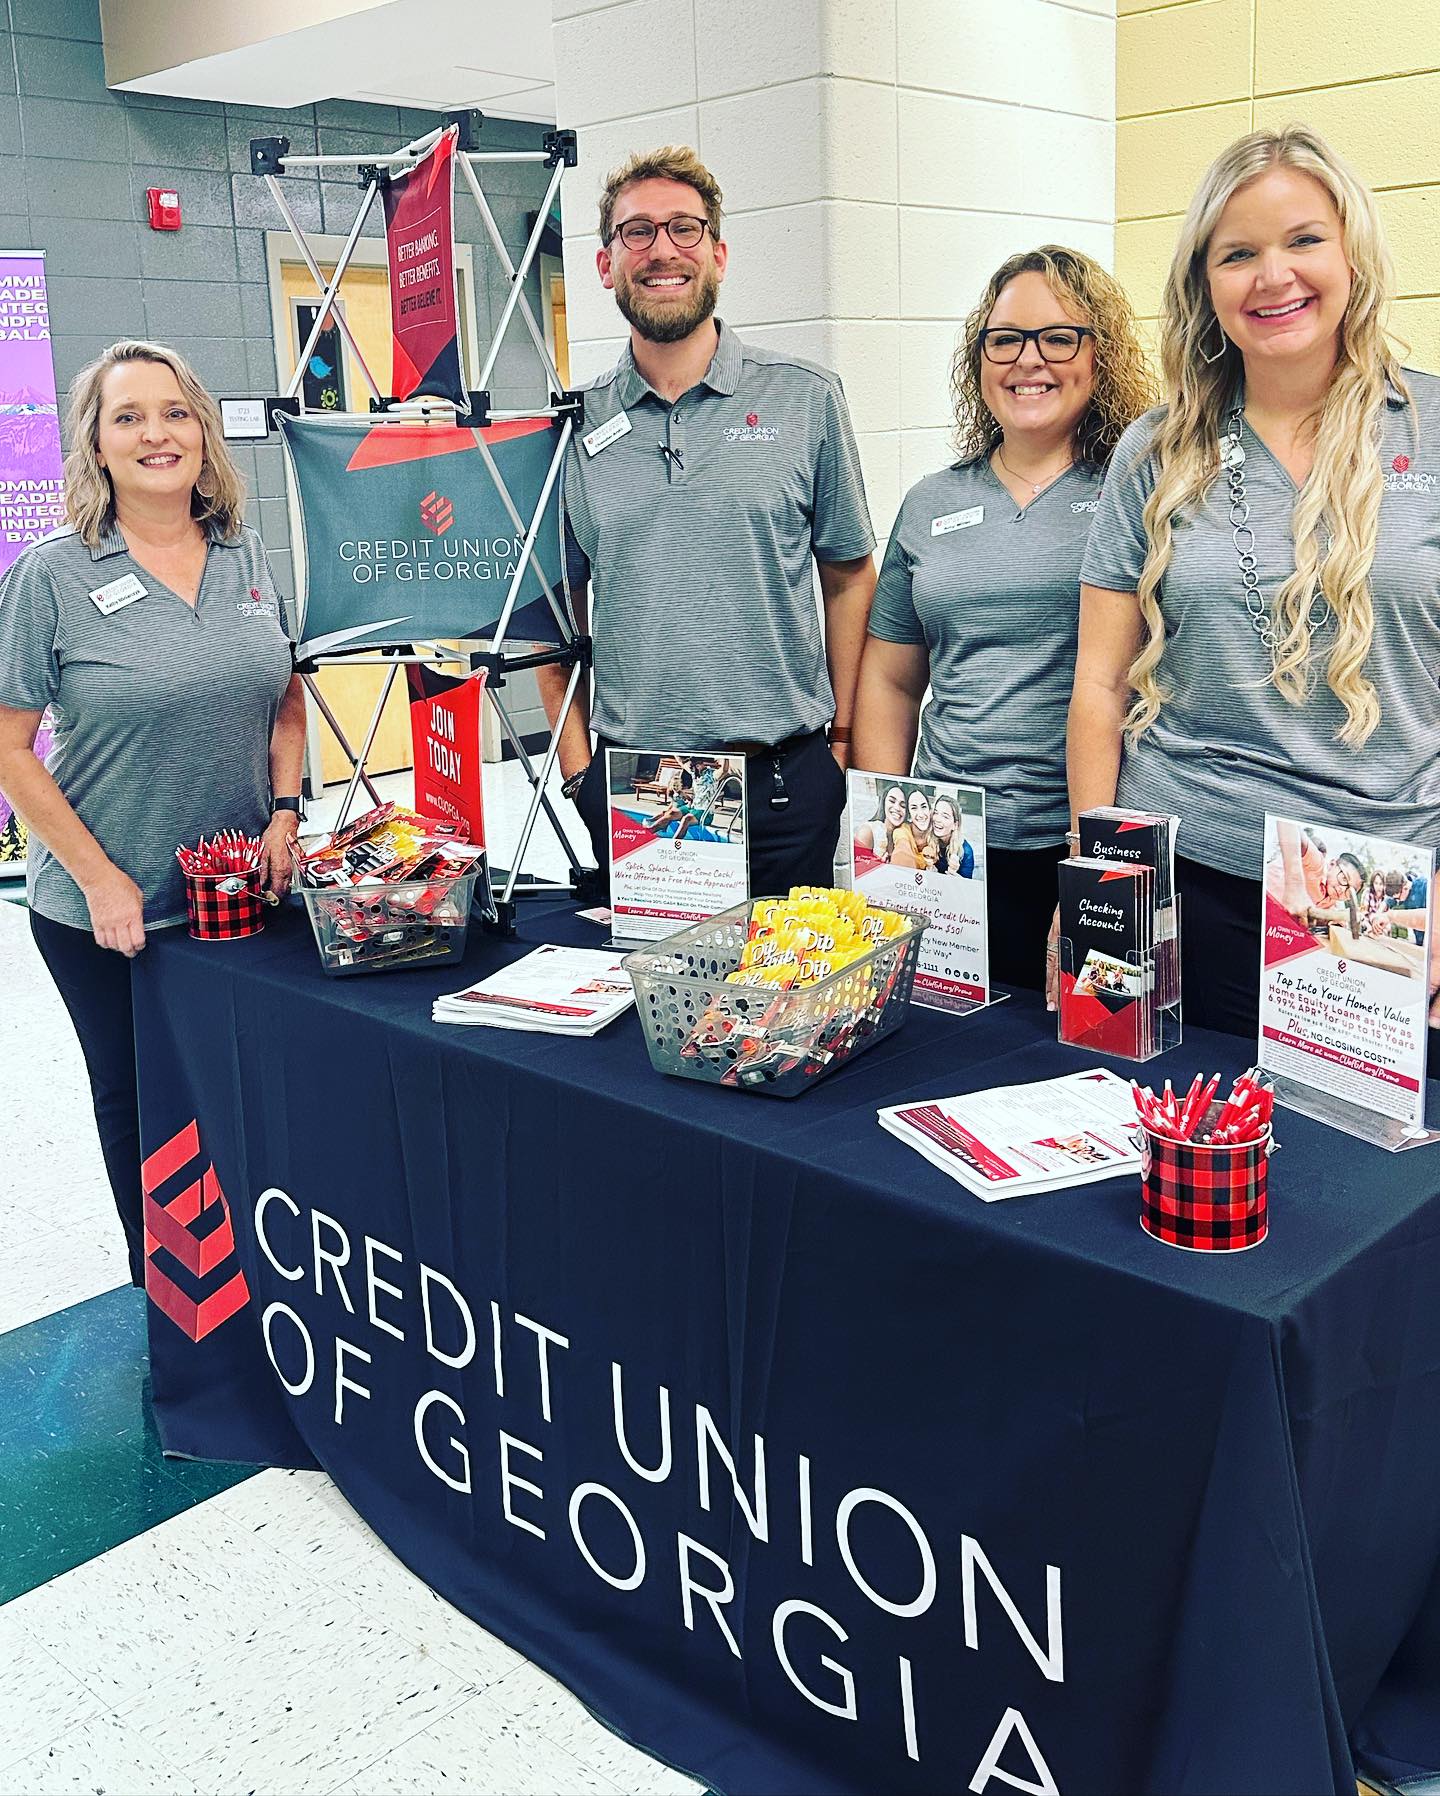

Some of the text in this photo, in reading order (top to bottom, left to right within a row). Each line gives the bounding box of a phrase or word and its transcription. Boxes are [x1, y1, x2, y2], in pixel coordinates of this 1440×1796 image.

[398, 242, 414, 262] BETTER
[399, 267, 416, 289] BETTER
[723, 427, 779, 435] CREDIT UNION
[1384, 482, 1431, 493] GEORGIA
[1402, 473, 1437, 484] UNION
[339, 537, 526, 561] CREDIT UNION
[352, 561, 519, 584] OF GEORGIA
[430, 702, 455, 743] JOIN
[427, 735, 462, 785] TODAY
[613, 831, 637, 842] Money
[1093, 841, 1141, 859] Business
[677, 866, 693, 875] Save
[695, 867, 712, 877] Some
[685, 876, 702, 885] Home
[895, 882, 942, 897] CREDIT UNION
[898, 889, 939, 902] OF GEORGIA
[644, 908, 658, 917] More
[886, 899, 909, 911] Friend
[919, 907, 932, 917] the
[934, 908, 957, 921] Credit
[959, 913, 980, 926] Union
[1079, 898, 1124, 920] Checking
[862, 916, 884, 938] Dip
[945, 925, 964, 935] $50!
[1078, 913, 1125, 932] Accounts
[932, 938, 948, 946] New
[949, 941, 980, 953] Member
[1266, 926, 1294, 945] Money
[752, 941, 778, 963] Dip
[799, 958, 832, 979] Dip
[1316, 967, 1366, 988] CREDIT UNION
[1320, 975, 1362, 994] OF GEORGIA
[1276, 972, 1411, 1025] Tap Into Your Home's Value
[1268, 994, 1296, 1010] 6.99%
[1325, 1012, 1340, 1024] for
[1342, 1019, 1355, 1031] up
[1358, 1024, 1368, 1034] to
[1372, 1028, 1382, 1039] 15
[1385, 1033, 1416, 1050] Years
[1269, 984, 1413, 1039] Home Equity Loans as low as
[1278, 1032, 1297, 1045] Learn
[1297, 1040, 1314, 1053] More
[1287, 1018, 1310, 1039] Plus,
[1311, 1032, 1323, 1042] NO
[1324, 1036, 1362, 1055] CLOSING
[255, 1187, 1065, 1683] CREDIT UNION
[261, 1301, 1061, 1796] OF GEORGIA
